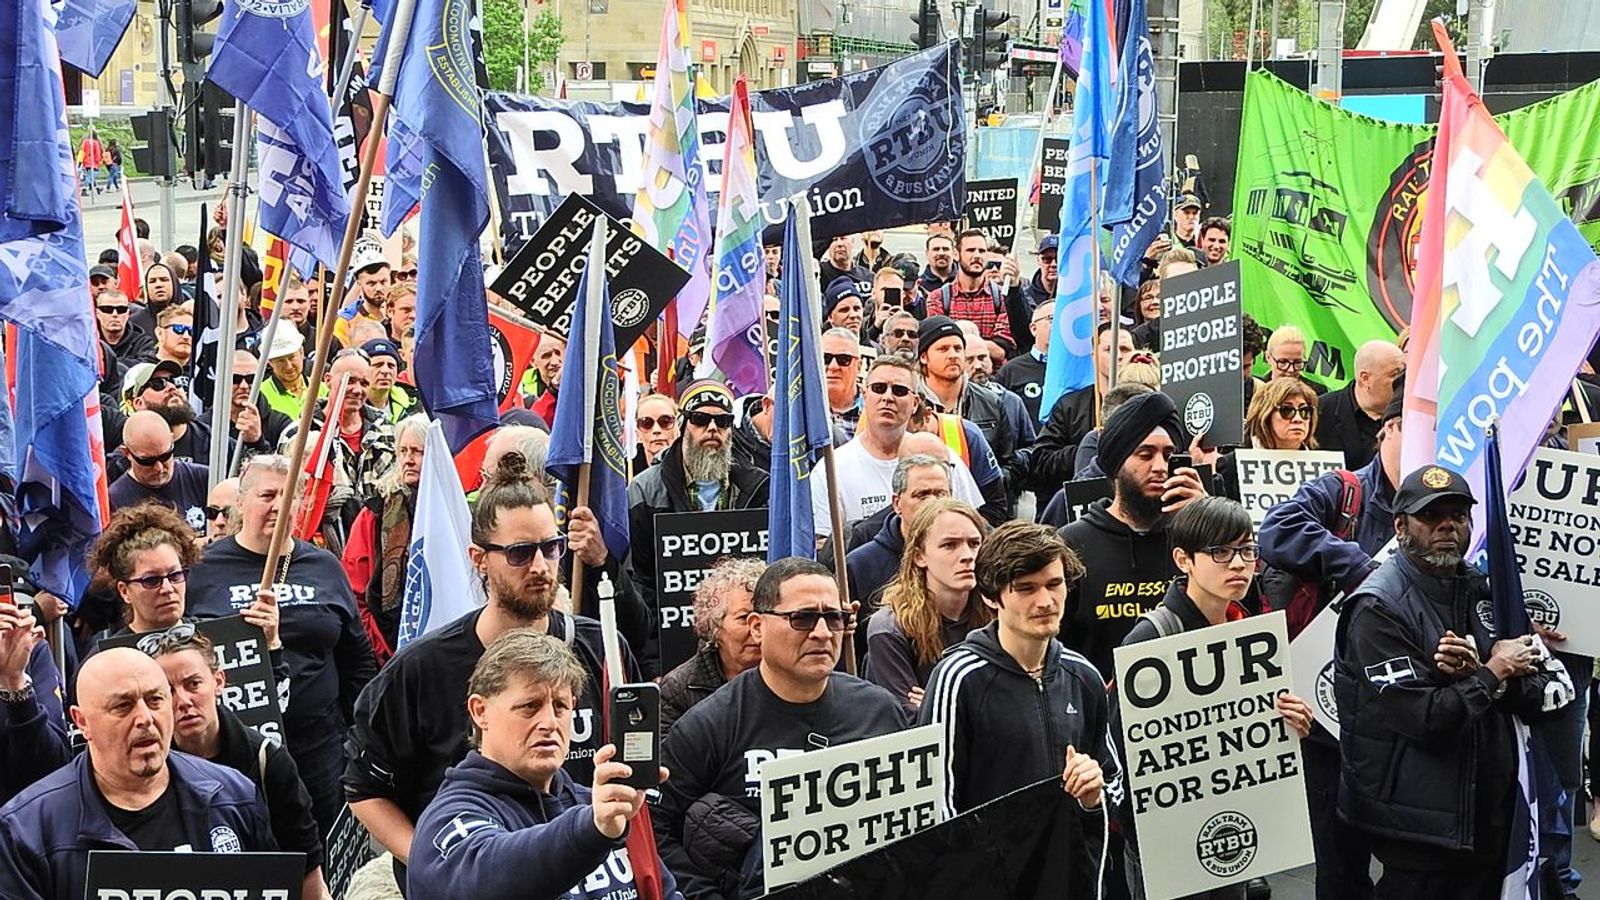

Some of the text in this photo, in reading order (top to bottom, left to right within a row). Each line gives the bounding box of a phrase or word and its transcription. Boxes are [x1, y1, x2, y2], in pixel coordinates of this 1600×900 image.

[435, 55, 480, 112] ESTABLISHE
[869, 101, 960, 172] RTBU
[974, 206, 1002, 222] WE
[507, 207, 595, 302] PEOPLE
[531, 227, 618, 318] BEFOE
[552, 236, 643, 336] PITS
[1163, 281, 1237, 319] PEOPLE
[615, 292, 644, 324] RTBU
[1163, 315, 1238, 351] BEFORE
[1161, 349, 1240, 385] PROFITS
[604, 377, 623, 439] LOCOMOTI
[1186, 406, 1212, 421] RTBU
[596, 426, 626, 469] ESTABLIS
[861, 494, 887, 505] RTBU
[1509, 503, 1600, 531] NDITION
[661, 530, 769, 557] PEOPLE
[1511, 523, 1600, 557] RE NO
[229, 583, 315, 603] RBU
[1105, 582, 1135, 597] END
[1124, 631, 1283, 709] OUR
[1135, 716, 1290, 777] ARE NOT
[769, 743, 940, 823] FIGHT
[1134, 752, 1299, 814] FOR SALE
[770, 801, 936, 868] FOR THE
[1200, 831, 1254, 858] RTBU
[1203, 818, 1222, 838] RAIL
[1222, 815, 1248, 828] TRAM
[1211, 864, 1227, 873] BUS
[1229, 850, 1252, 873] UNION
